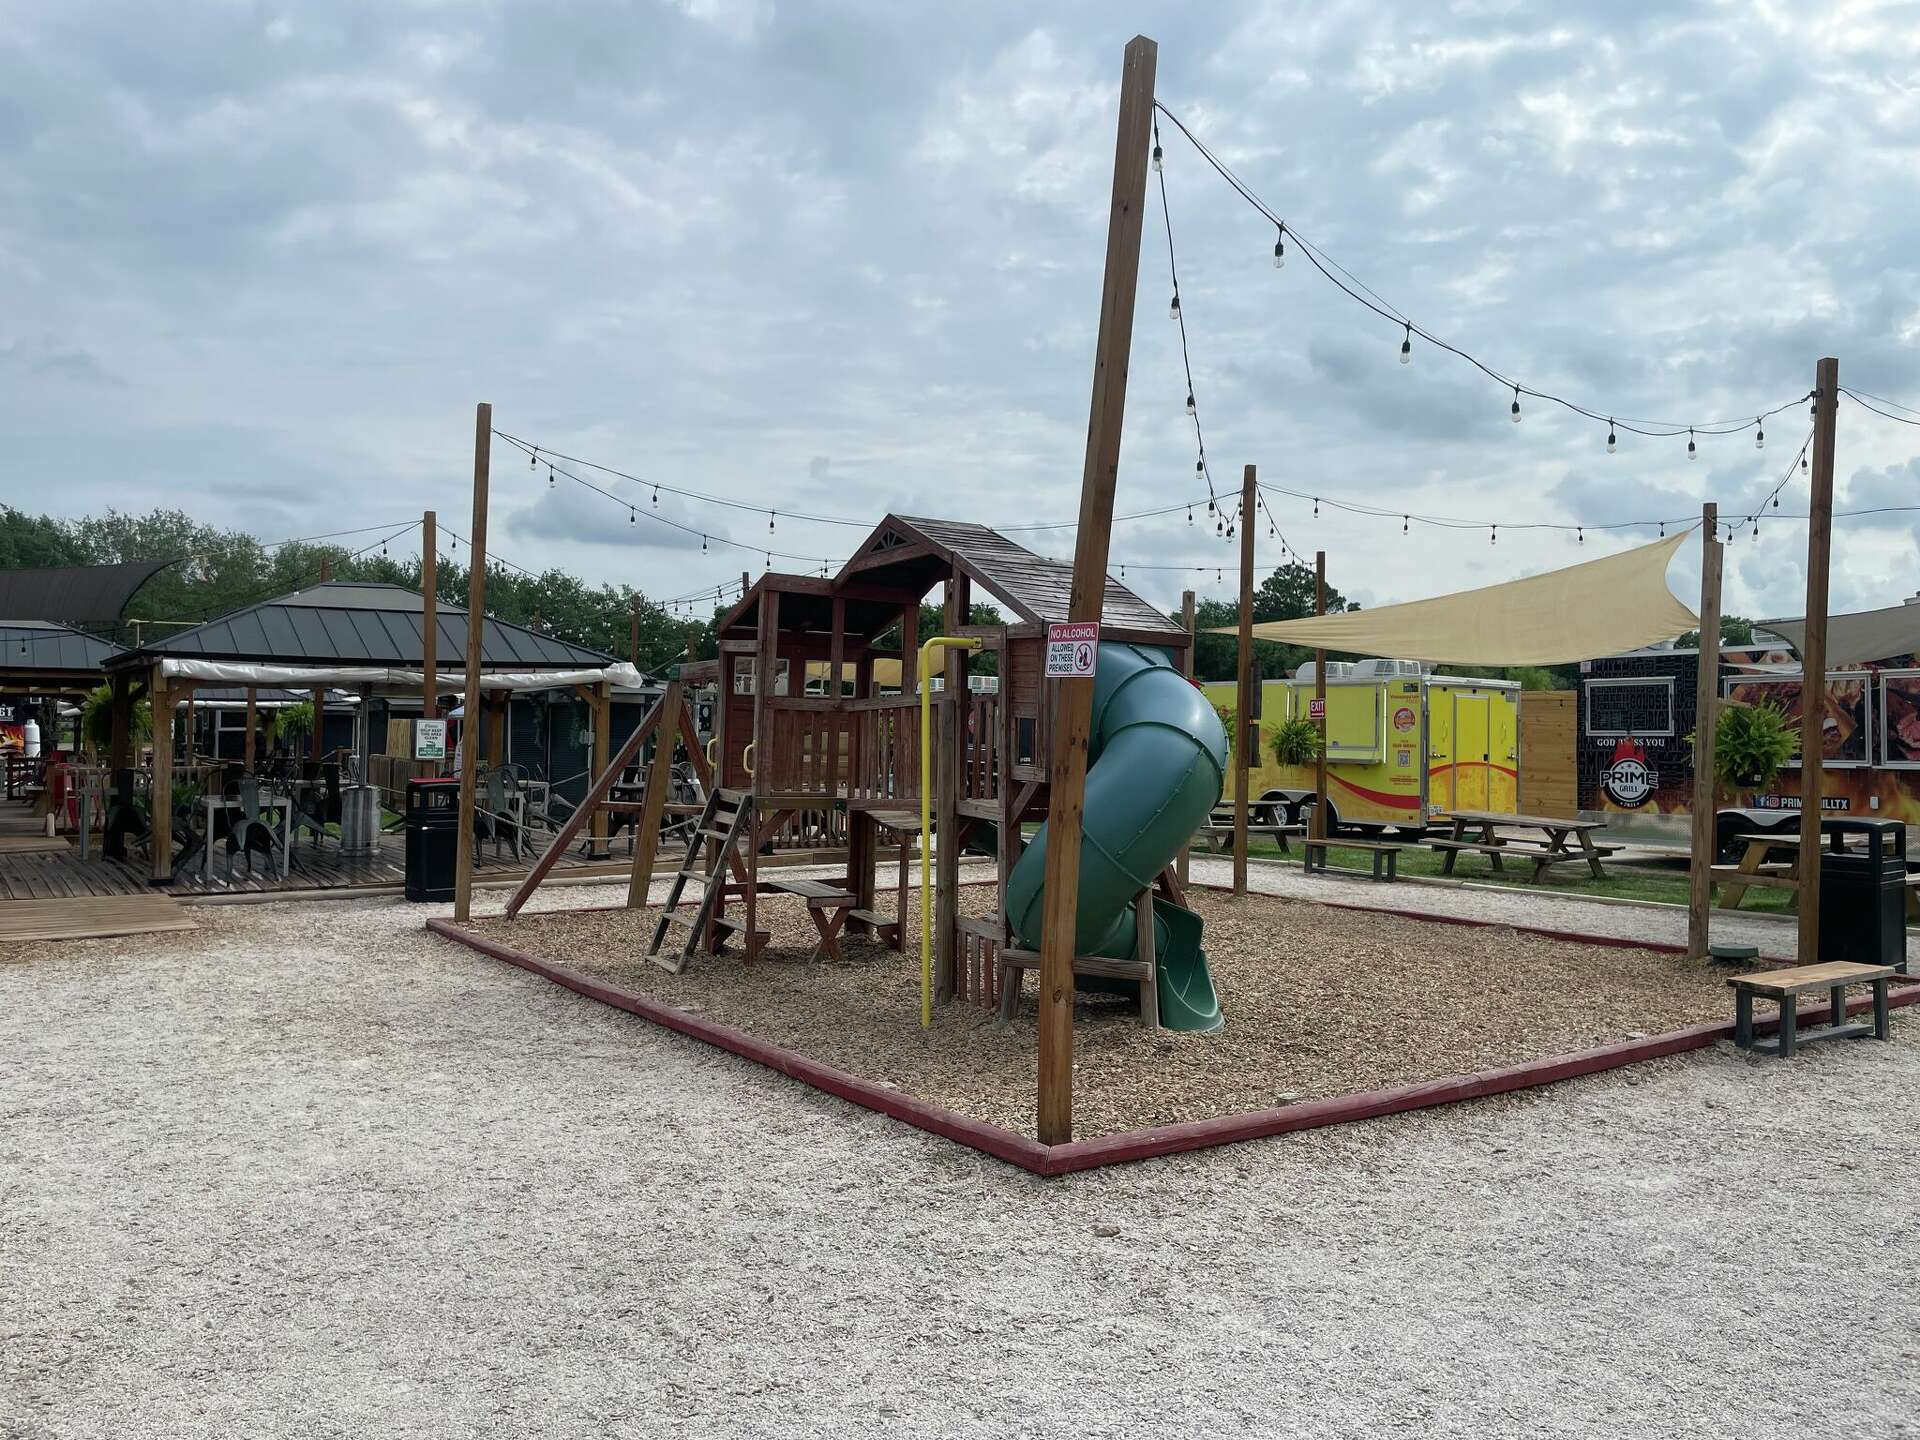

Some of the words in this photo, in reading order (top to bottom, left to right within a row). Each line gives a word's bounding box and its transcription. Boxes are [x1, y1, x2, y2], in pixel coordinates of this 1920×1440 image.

[1051, 629, 1061, 639] NO
[1062, 628, 1095, 639] ALCOHOL
[1051, 643, 1074, 652] ALLOWED
[1050, 654, 1057, 662] ON
[1058, 653, 1074, 662] THESE
[1048, 663, 1073, 672] PREMISES
[1311, 701, 1324, 711] EXIT
[1645, 738, 1665, 746] YOU
[1600, 771, 1659, 789] PRIME
[1781, 798, 1848, 809] PRIMILLTX
